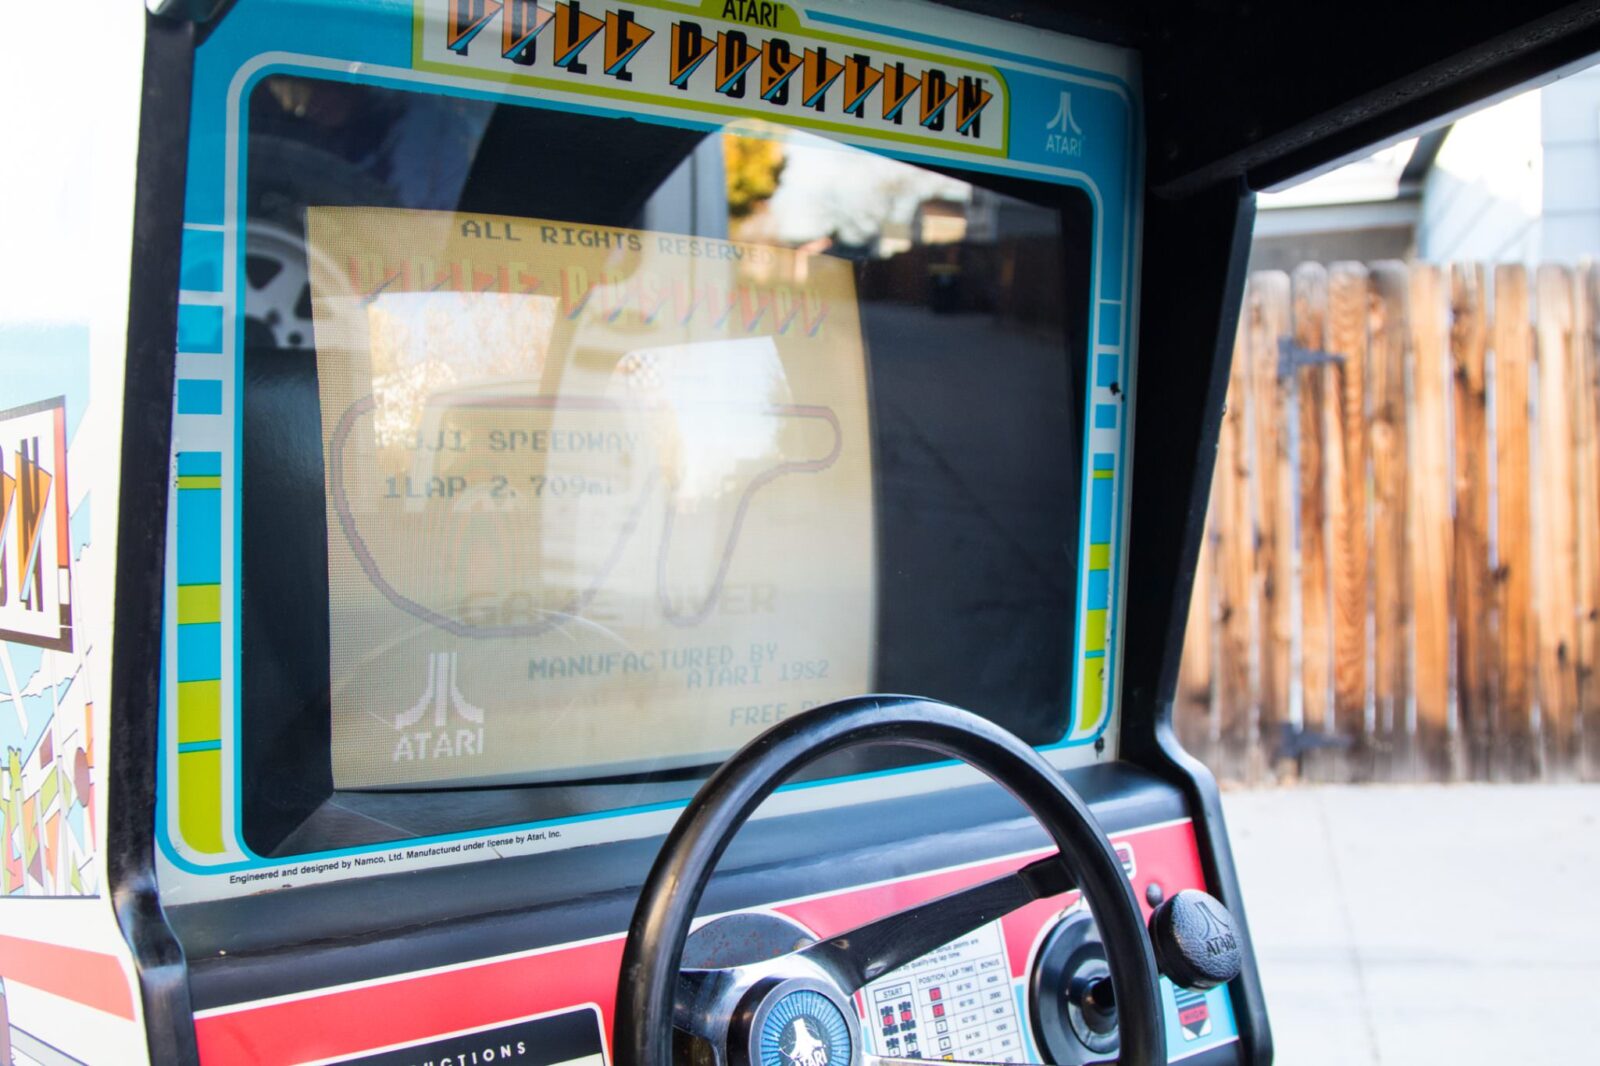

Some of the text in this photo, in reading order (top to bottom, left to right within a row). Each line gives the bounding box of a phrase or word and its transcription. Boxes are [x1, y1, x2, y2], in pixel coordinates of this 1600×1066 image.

[722, 0, 778, 28] ATARI
[447, 0, 993, 138] POLE POSITION
[1045, 134, 1082, 157] ATARI
[461, 219, 522, 242] ALL
[540, 225, 643, 251] RIGHTS
[489, 429, 640, 452] SPEEDWAY
[527, 642, 778, 681] MANUFACTURED BY
[687, 664, 763, 689] ATARI
[730, 703, 788, 727] FREE
[393, 728, 485, 762] ATARI
[229, 831, 562, 884] Engineered and designed by Namco, Ltd. Manufactured under license by Atari, Inc.
[918, 972, 946, 984] POSITION
[883, 987, 903, 998] START
